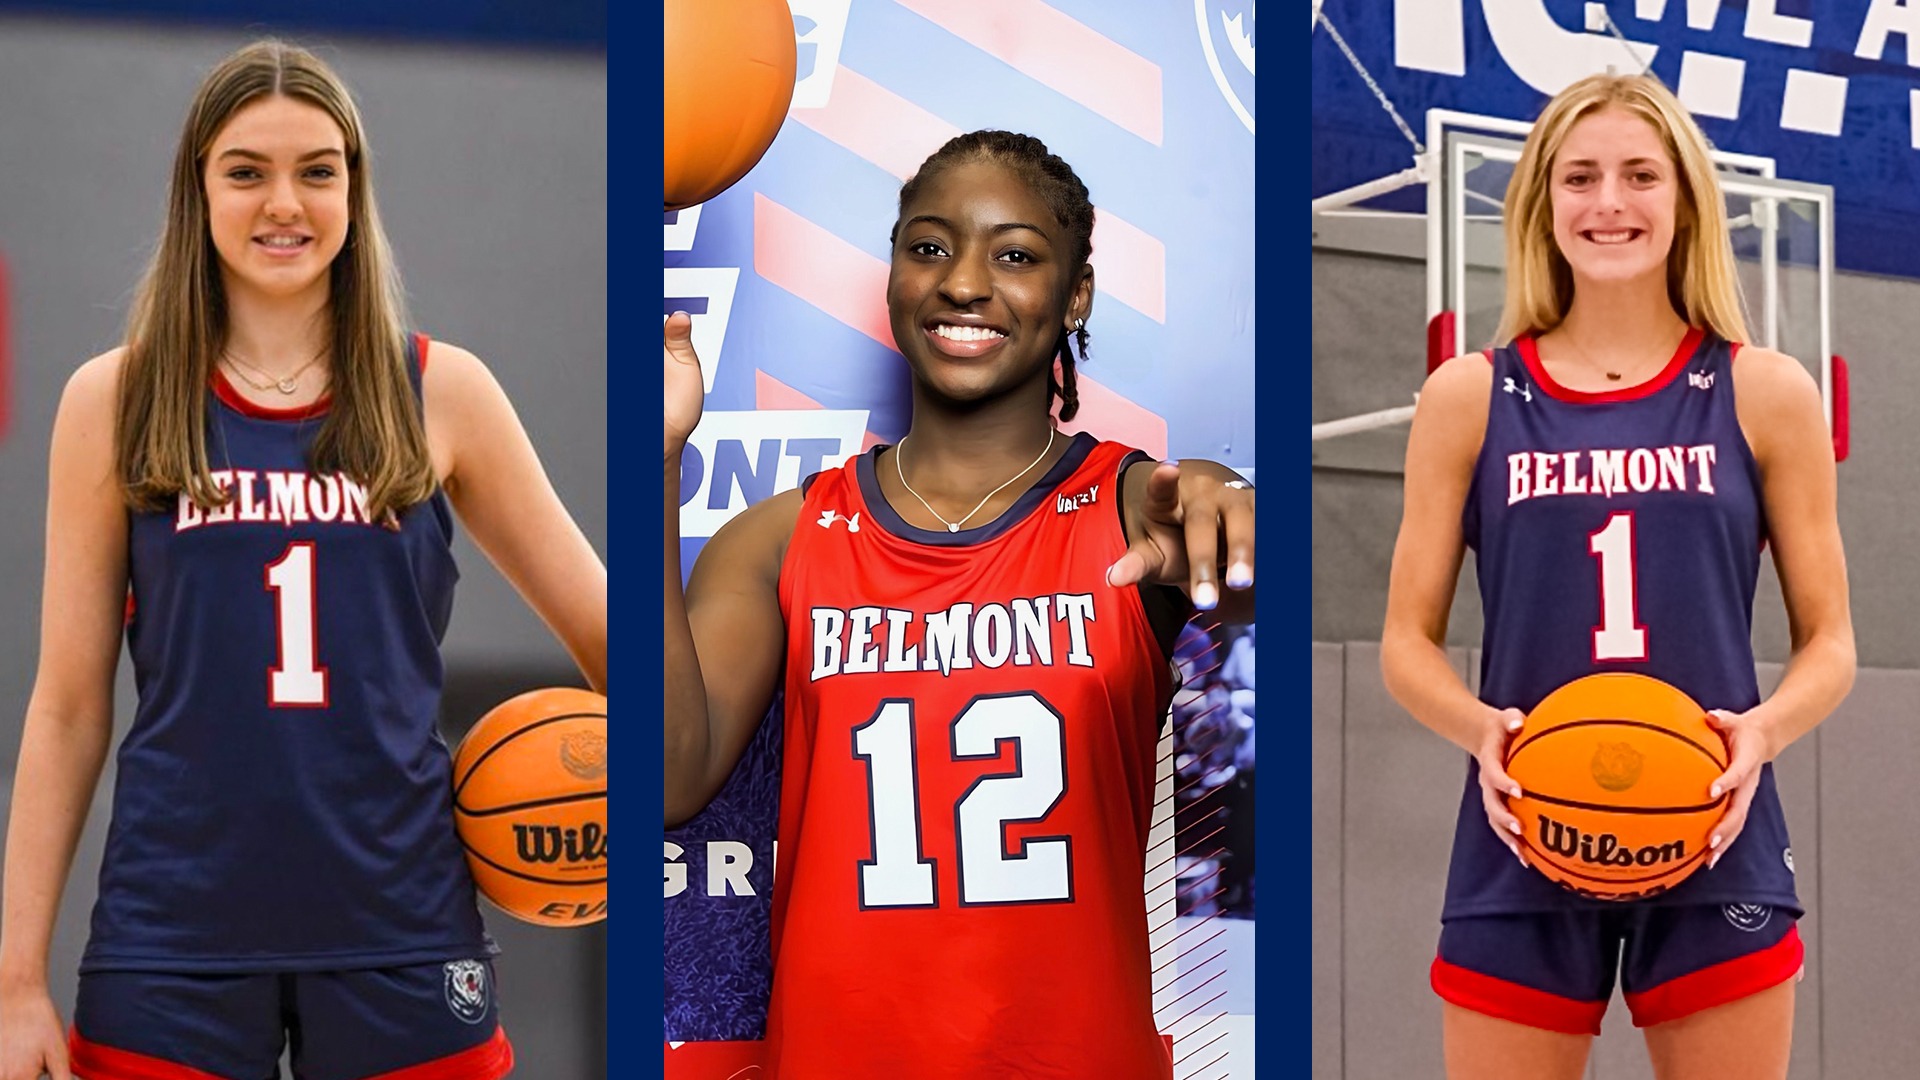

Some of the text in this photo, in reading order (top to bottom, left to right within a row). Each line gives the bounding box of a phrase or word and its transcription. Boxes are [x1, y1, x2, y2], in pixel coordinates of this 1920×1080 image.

[176, 468, 401, 534] BELMON
[1507, 445, 1717, 505] BELMONT
[265, 541, 329, 708] 1
[1588, 510, 1650, 664] 1
[810, 593, 1096, 681] BELMONT
[851, 691, 1075, 911] 12
[1537, 814, 1685, 867] Wilson
